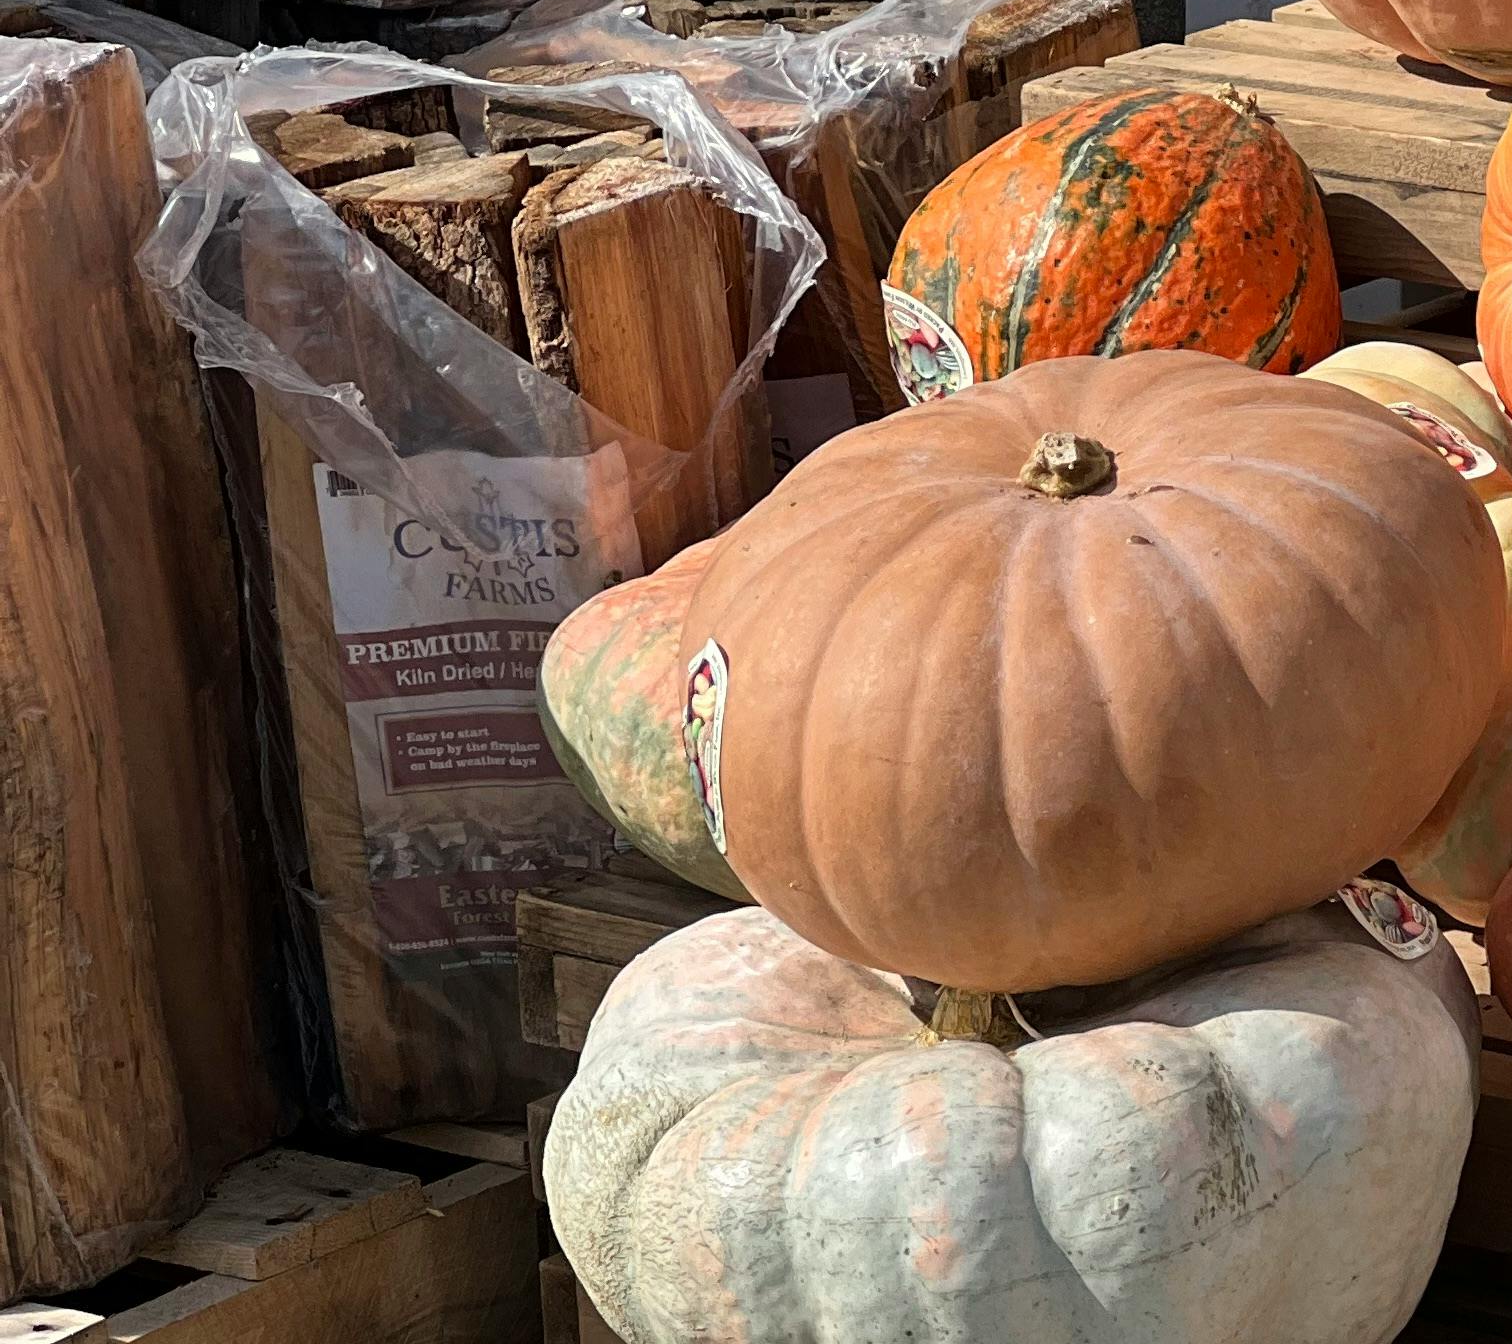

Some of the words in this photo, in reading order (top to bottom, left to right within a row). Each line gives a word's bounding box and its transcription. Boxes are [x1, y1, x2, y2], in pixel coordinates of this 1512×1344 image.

[443, 572, 556, 606] FARMS
[345, 630, 501, 666] PREMIUM
[396, 667, 438, 687] Kiln
[442, 662, 496, 682] Dried
[510, 661, 537, 680] He
[405, 731, 439, 744] Easy
[440, 729, 456, 741] to
[457, 727, 490, 739] start
[407, 744, 445, 759] Camp
[447, 743, 463, 756] by
[465, 741, 488, 753] the
[489, 740, 542, 755] fireplace
[410, 762, 427, 772] on
[429, 759, 454, 771] bad
[455, 757, 507, 768] weather
[508, 756, 538, 769] days
[437, 883, 517, 909] Easte
[453, 910, 511, 926] Forest
